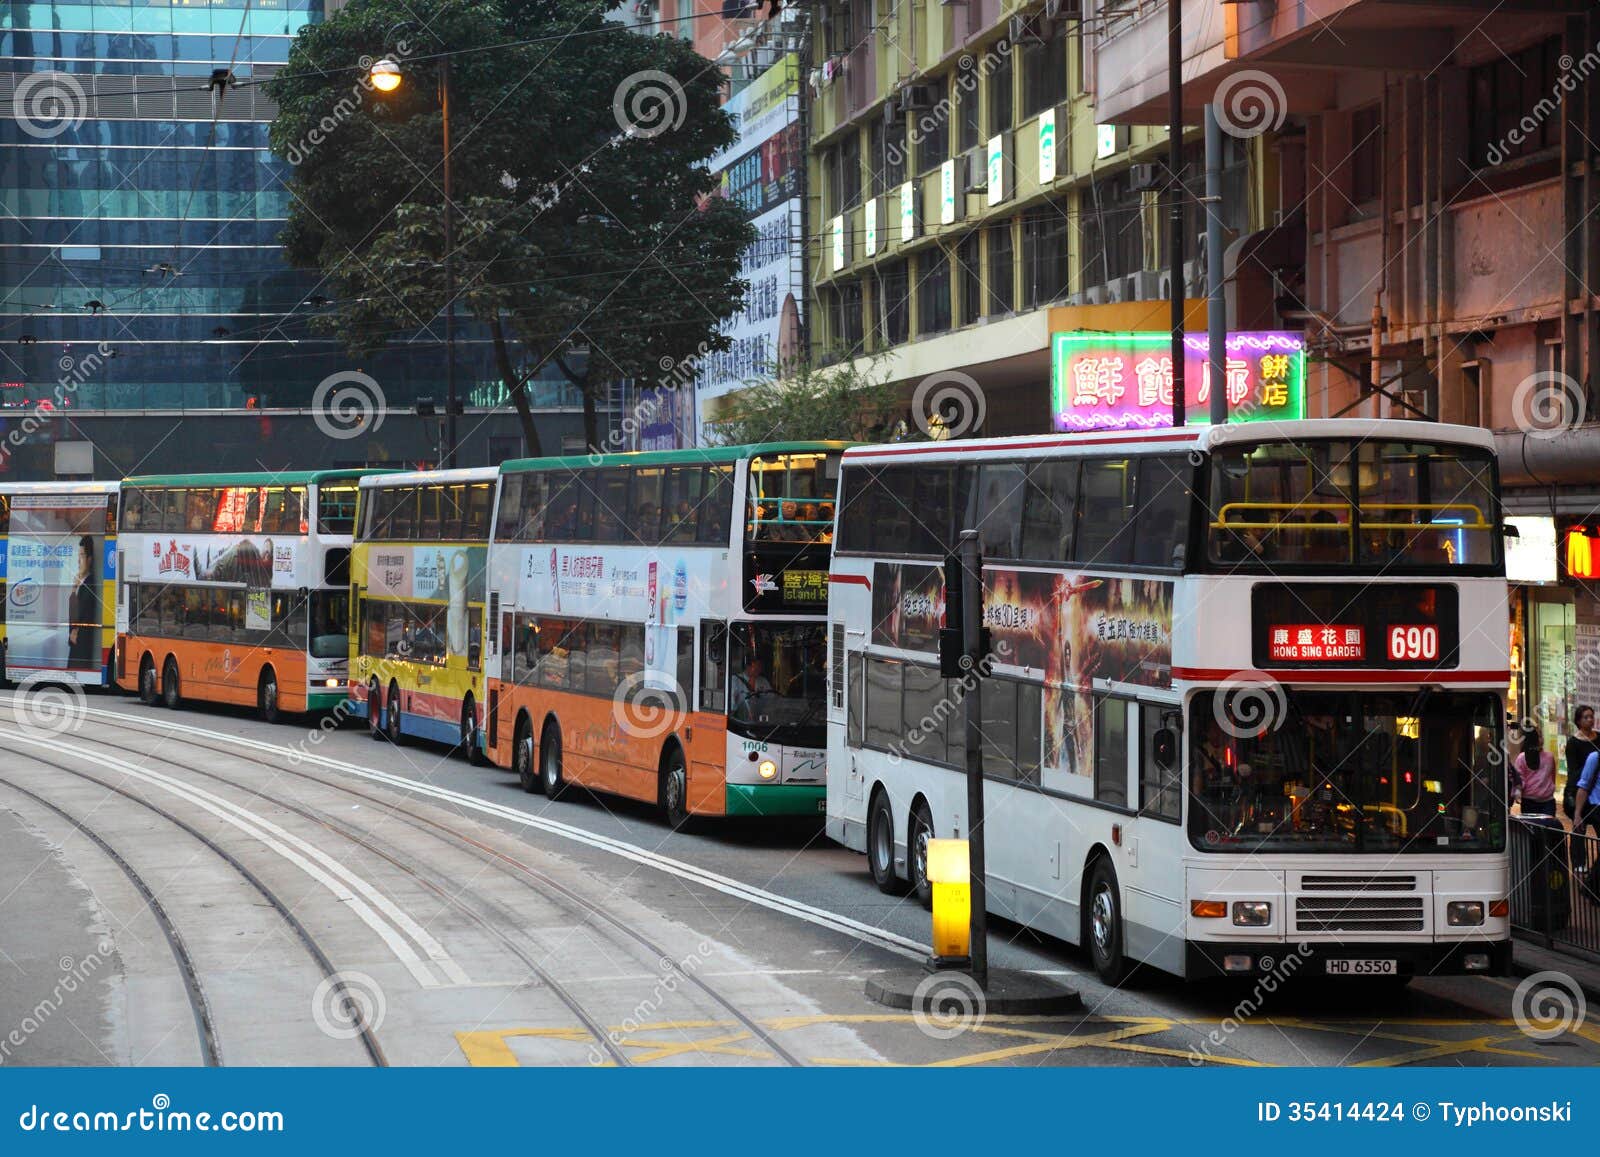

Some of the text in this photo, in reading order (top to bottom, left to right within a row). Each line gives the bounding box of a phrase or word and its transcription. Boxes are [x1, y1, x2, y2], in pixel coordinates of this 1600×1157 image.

[1260, 354, 1289, 406] 餅店
[784, 588, 816, 600] Island
[1273, 629, 1361, 645] 康盛花園
[1391, 627, 1437, 659] 690
[1273, 646, 1361, 657] HONG SING GARDEN
[742, 741, 769, 753] 1006
[1331, 961, 1392, 973] HD 6550
